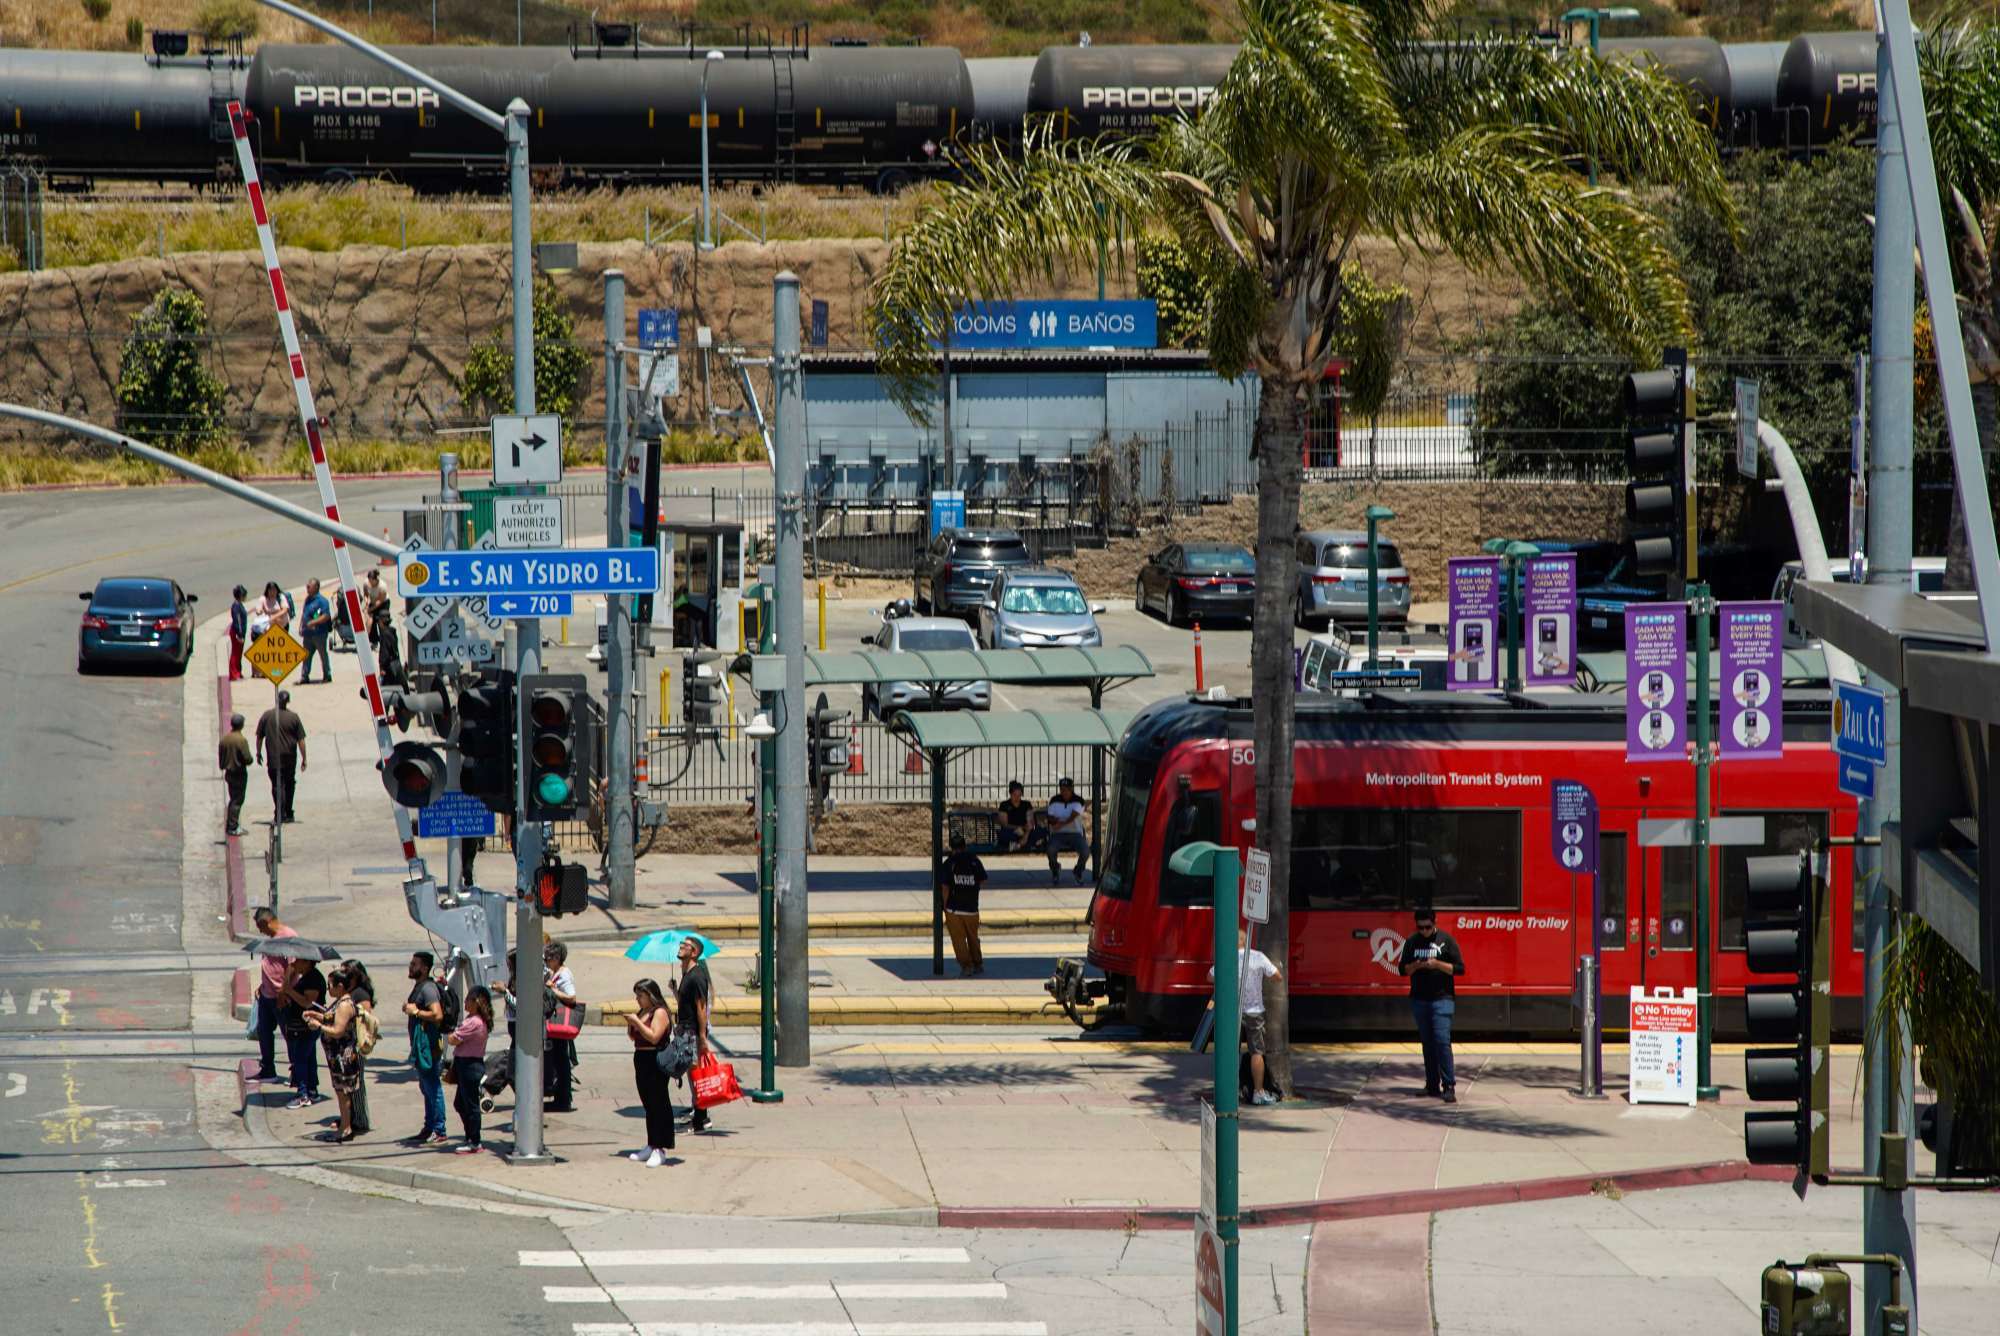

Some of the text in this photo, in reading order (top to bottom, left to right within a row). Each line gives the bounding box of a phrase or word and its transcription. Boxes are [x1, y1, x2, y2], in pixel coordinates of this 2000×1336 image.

[294, 85, 440, 108] PROCOR
[313, 115, 341, 127] PROX
[1069, 312, 1135, 333] BAÑOS
[511, 504, 544, 515] EXCEPT
[501, 518, 556, 529] AUTHORIZED
[507, 531, 551, 542] VEHICLES
[438, 561, 460, 586] E.
[530, 596, 559, 613] 700
[448, 623, 460, 639] 2
[1730, 624, 1753, 632] EVERY
[267, 636, 286, 648] NO
[253, 652, 300, 664] OUTLET
[422, 644, 488, 659] TRACKS
[1844, 699, 1864, 743] RAIL
[1232, 748, 1256, 765] 50
[1365, 772, 1542, 788] Metropolitan Transit System
[1456, 917, 1569, 931] San Diego Trolley
[1645, 1005, 1693, 1017] No Trolley
